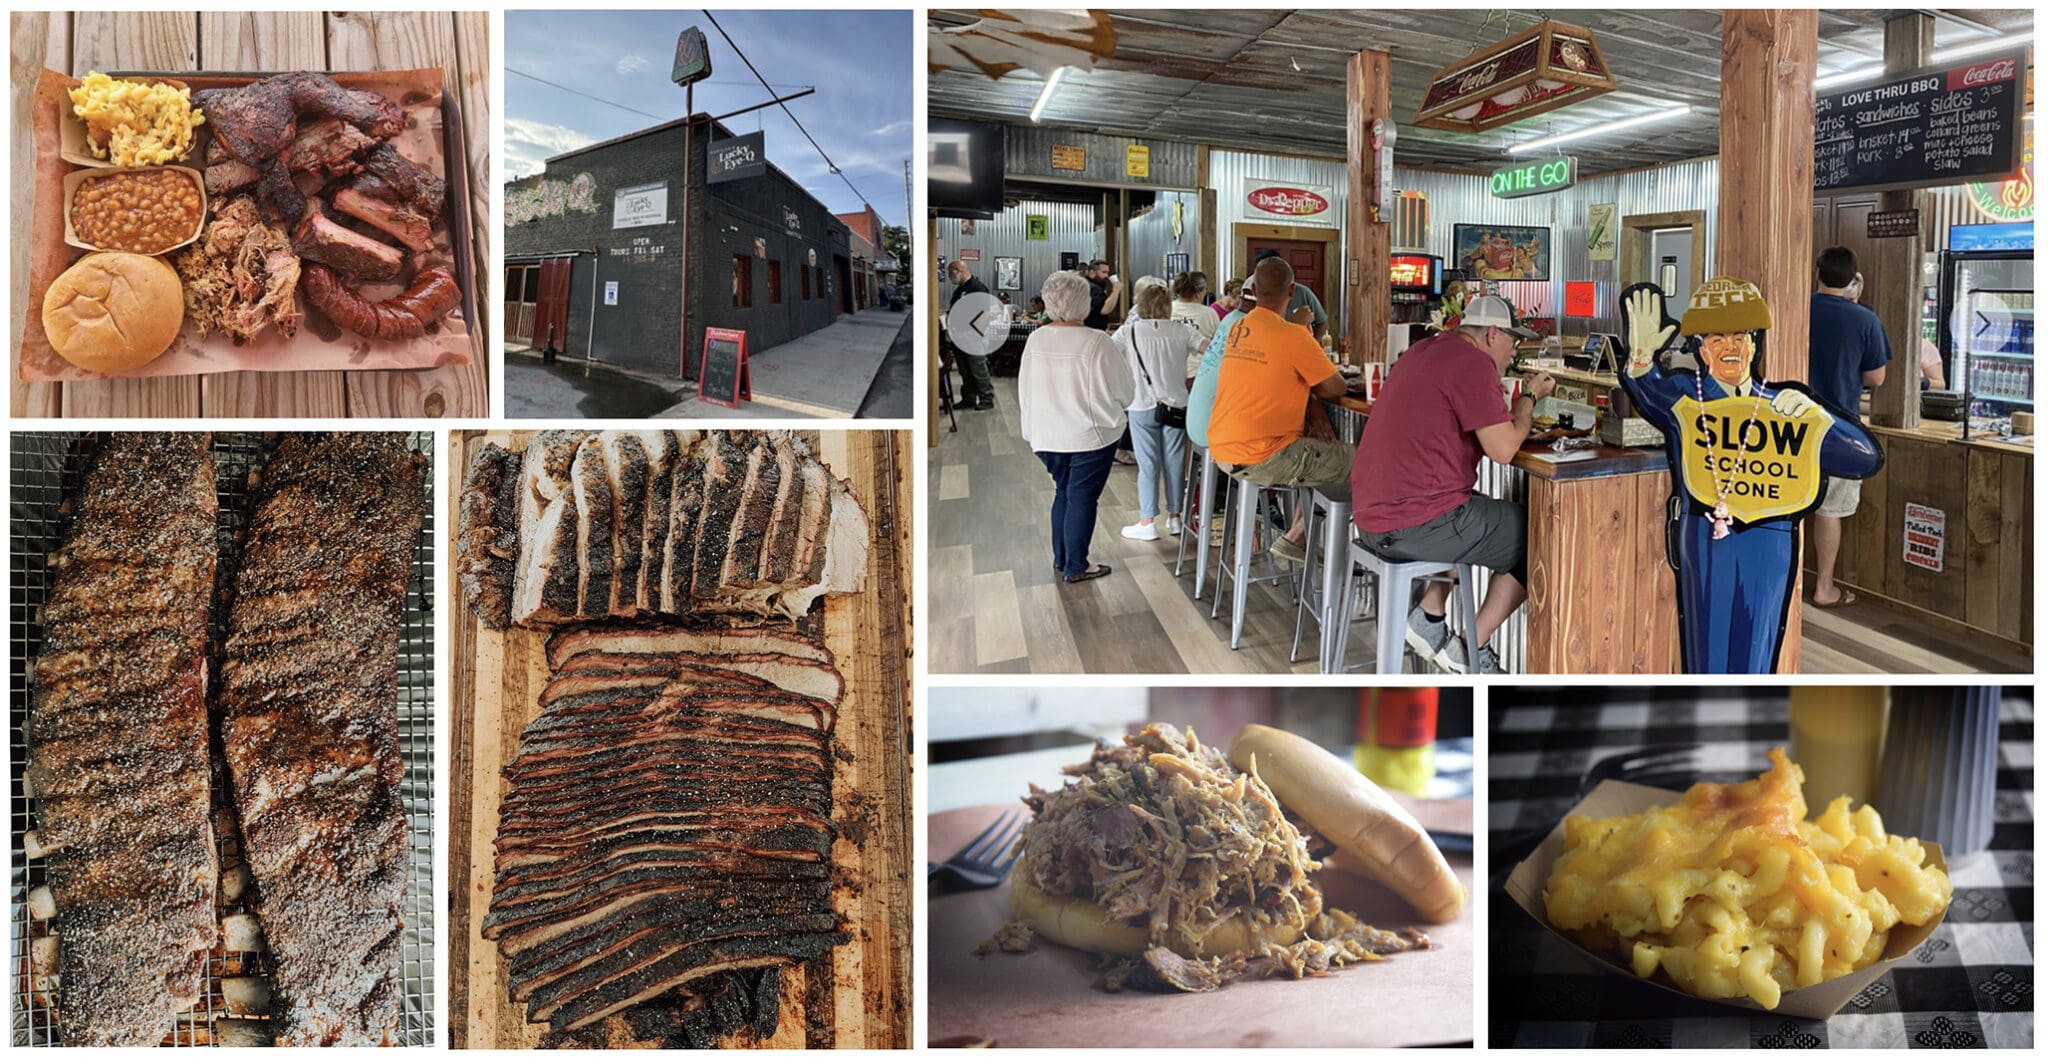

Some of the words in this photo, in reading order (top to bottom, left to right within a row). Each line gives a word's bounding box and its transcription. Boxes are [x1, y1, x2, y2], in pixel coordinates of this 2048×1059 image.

[1841, 91, 1872, 107] LOVE
[1873, 83, 1908, 101] THRU
[1911, 78, 1940, 94] BBQ
[1855, 101, 1921, 124] sandwiches
[1930, 91, 1973, 112] sides
[1930, 110, 1960, 128] baked
[1962, 107, 1997, 123] beans
[719, 146, 749, 162] Lucky
[1934, 159, 1961, 171] slaw
[1491, 172, 1512, 193] ON
[1514, 166, 1536, 189] THE
[1541, 161, 1567, 186] GO
[650, 246, 664, 254] SAT
[1695, 414, 1809, 456] SLOW
[1704, 455, 1799, 479] SCHOOL
[1720, 479, 1780, 499] ZONE
[1909, 543, 1937, 558] RIBS
